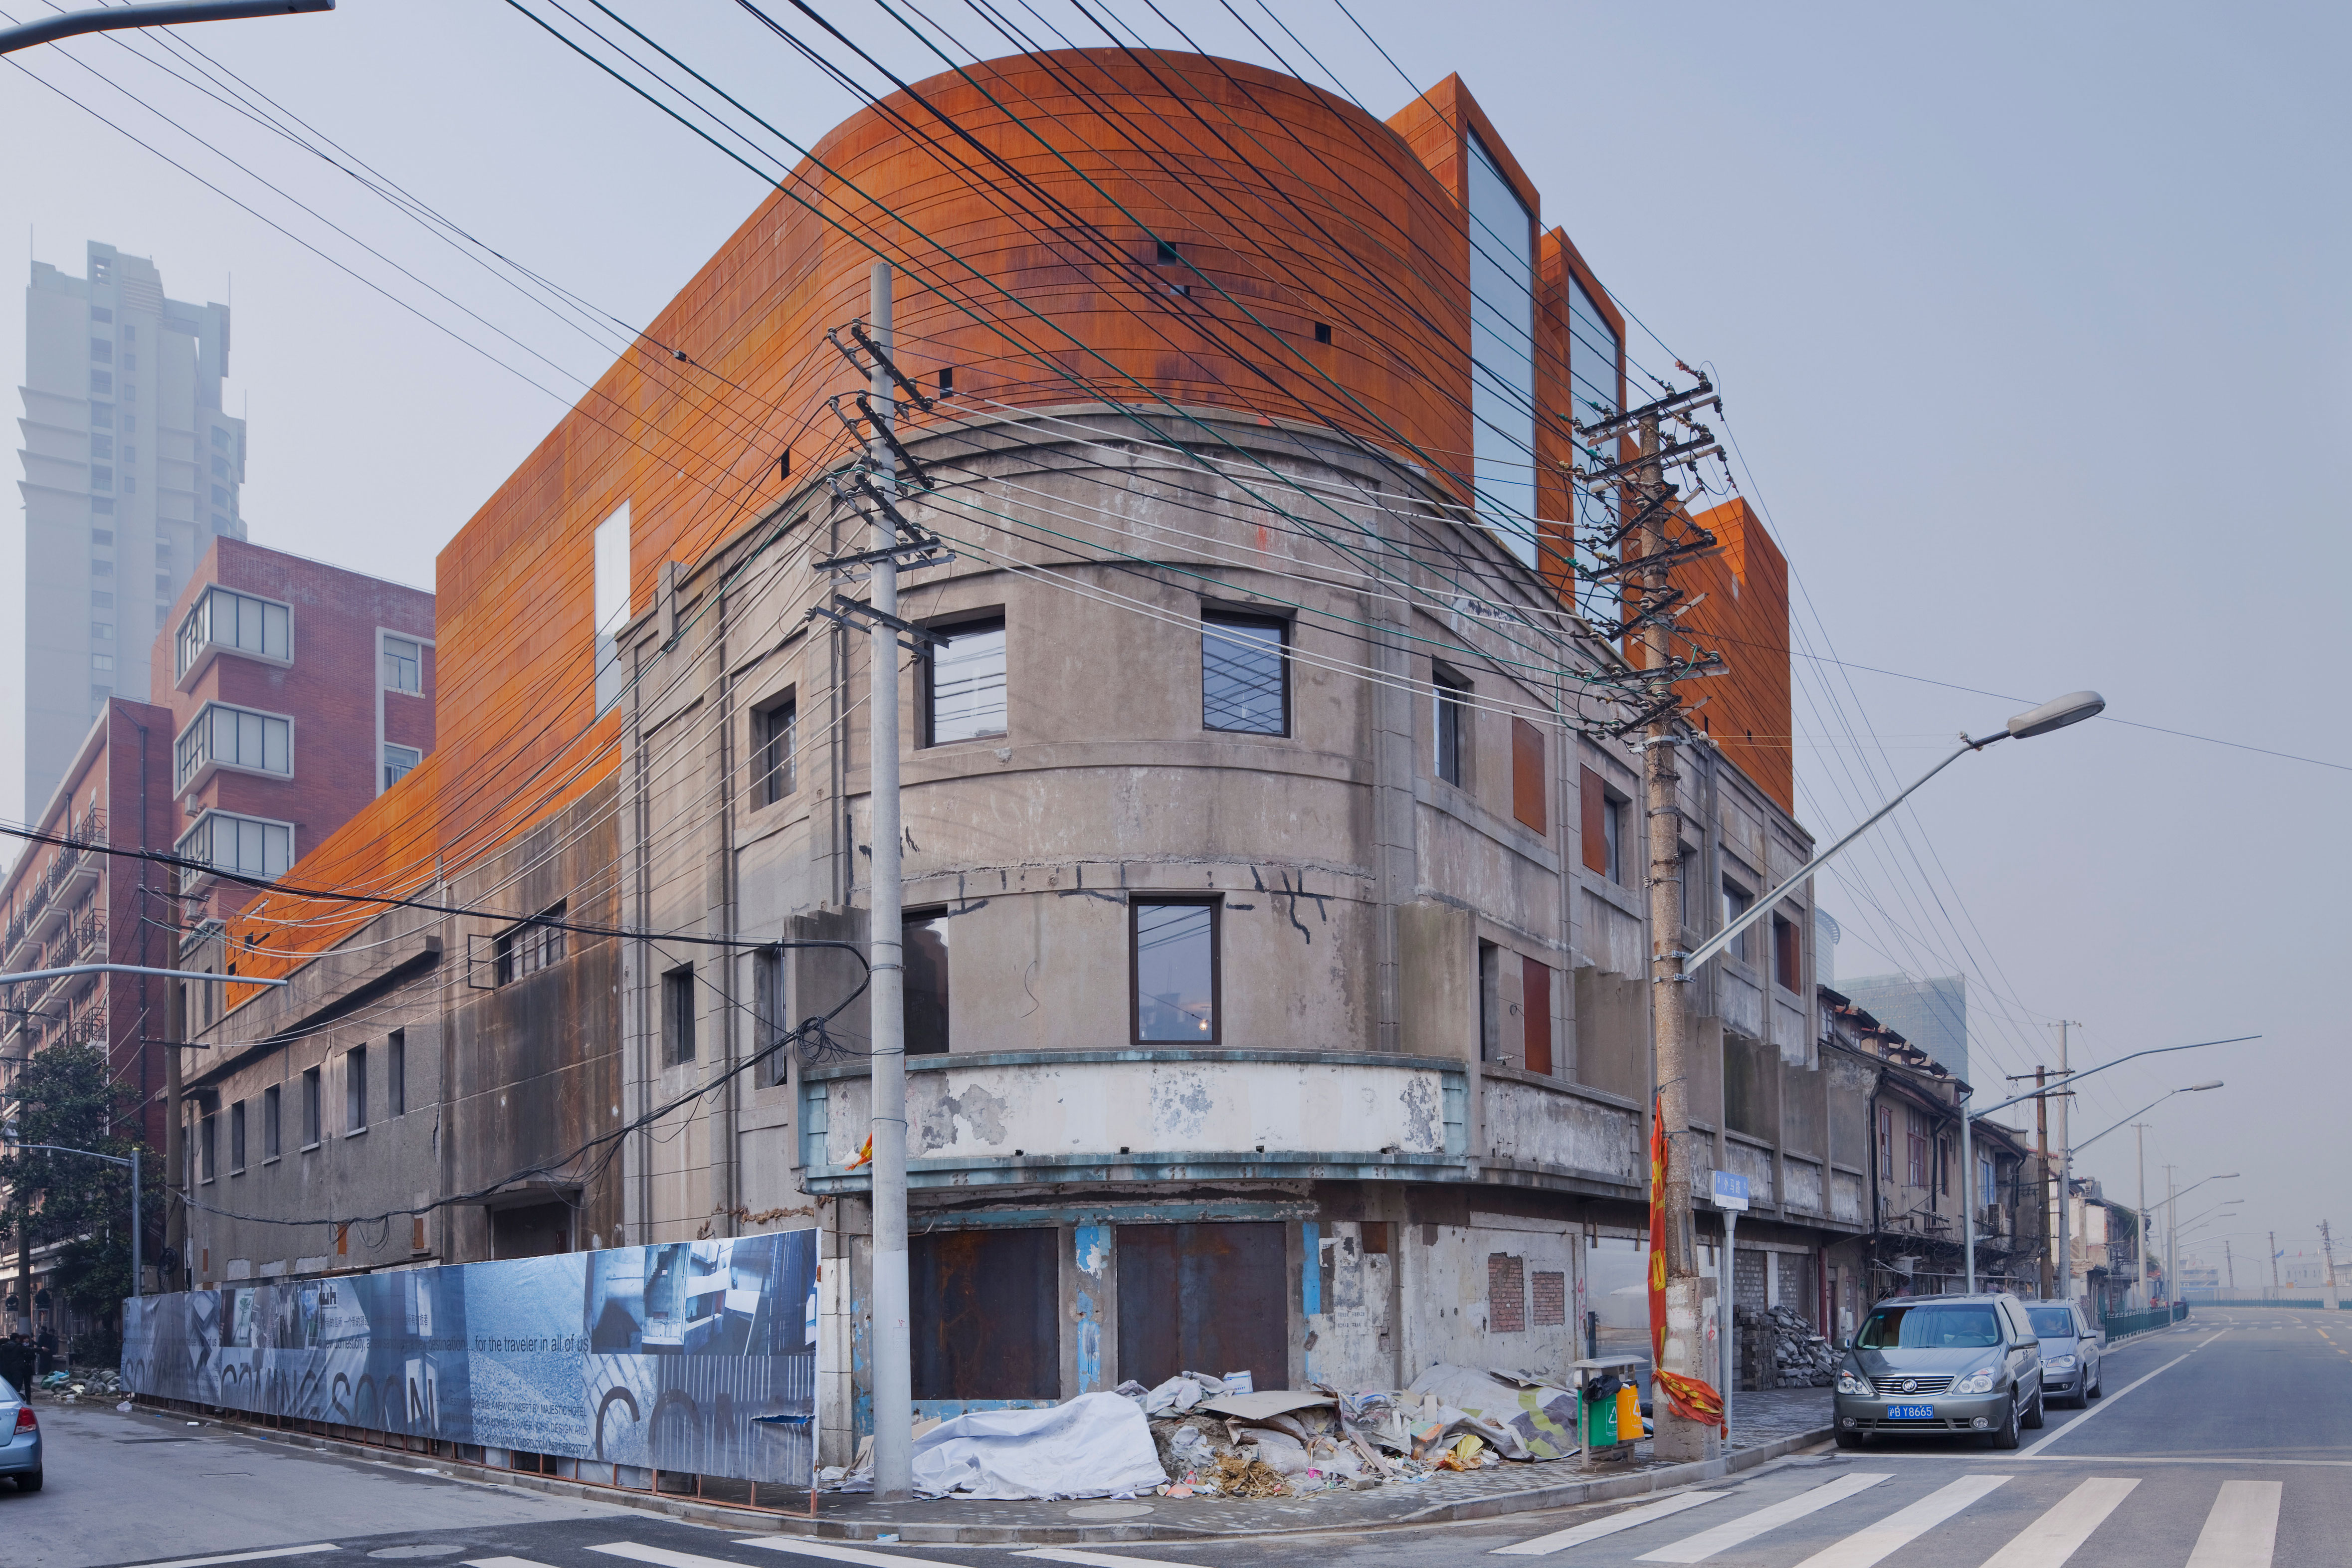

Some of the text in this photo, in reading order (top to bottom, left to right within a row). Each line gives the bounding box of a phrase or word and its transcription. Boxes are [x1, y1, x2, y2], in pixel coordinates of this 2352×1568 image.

[1724, 1177, 1741, 1194] 外马路
[475, 1336, 487, 1352] for
[489, 1336, 502, 1352] the
[504, 1335, 537, 1352] traveler
[540, 1335, 548, 1352] in
[551, 1334, 562, 1352] all
[565, 1334, 575, 1352] of
[577, 1337, 589, 1352] us
[508, 1402, 532, 1413] CONCEPT
[533, 1403, 539, 1413] BY
[541, 1404, 567, 1415] MAJESTIC
[568, 1406, 587, 1417] HOTEL
[483, 1417, 510, 1428] DESIGNED
[551, 1422, 573, 1434] DESIGN
[575, 1424, 587, 1436] AND
[562, 1442, 588, 1455] 60823777
